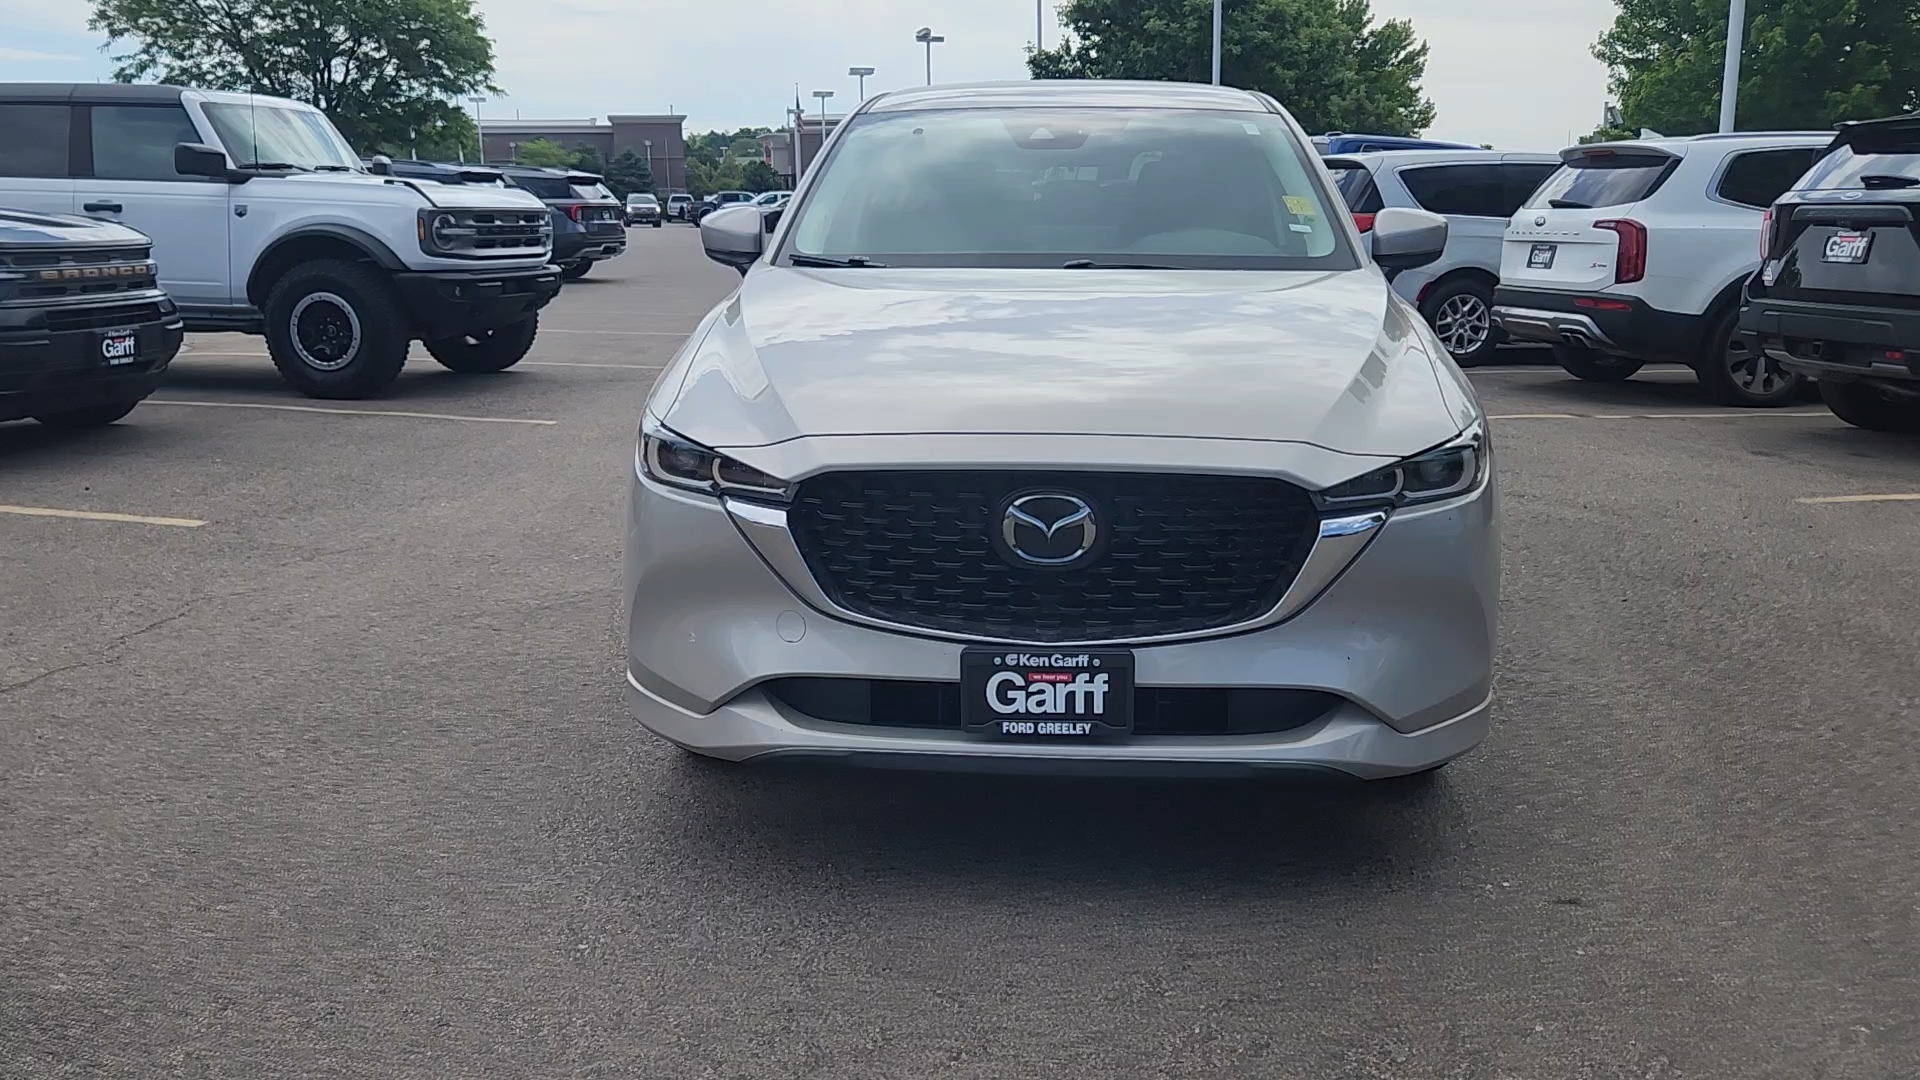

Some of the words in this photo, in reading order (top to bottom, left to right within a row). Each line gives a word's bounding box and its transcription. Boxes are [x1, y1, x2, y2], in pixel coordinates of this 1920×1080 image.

[1826, 236, 1868, 257] Garff
[39, 265, 147, 280] BRONCO
[102, 336, 135, 358] Garff
[1019, 654, 1049, 667] Ken
[1050, 654, 1090, 667] Garff
[1042, 673, 1056, 681] hear
[1056, 674, 1068, 682] you
[985, 671, 1109, 714] Garff
[1002, 722, 1035, 734] FORD
[1037, 722, 1092, 735] GREELEY
